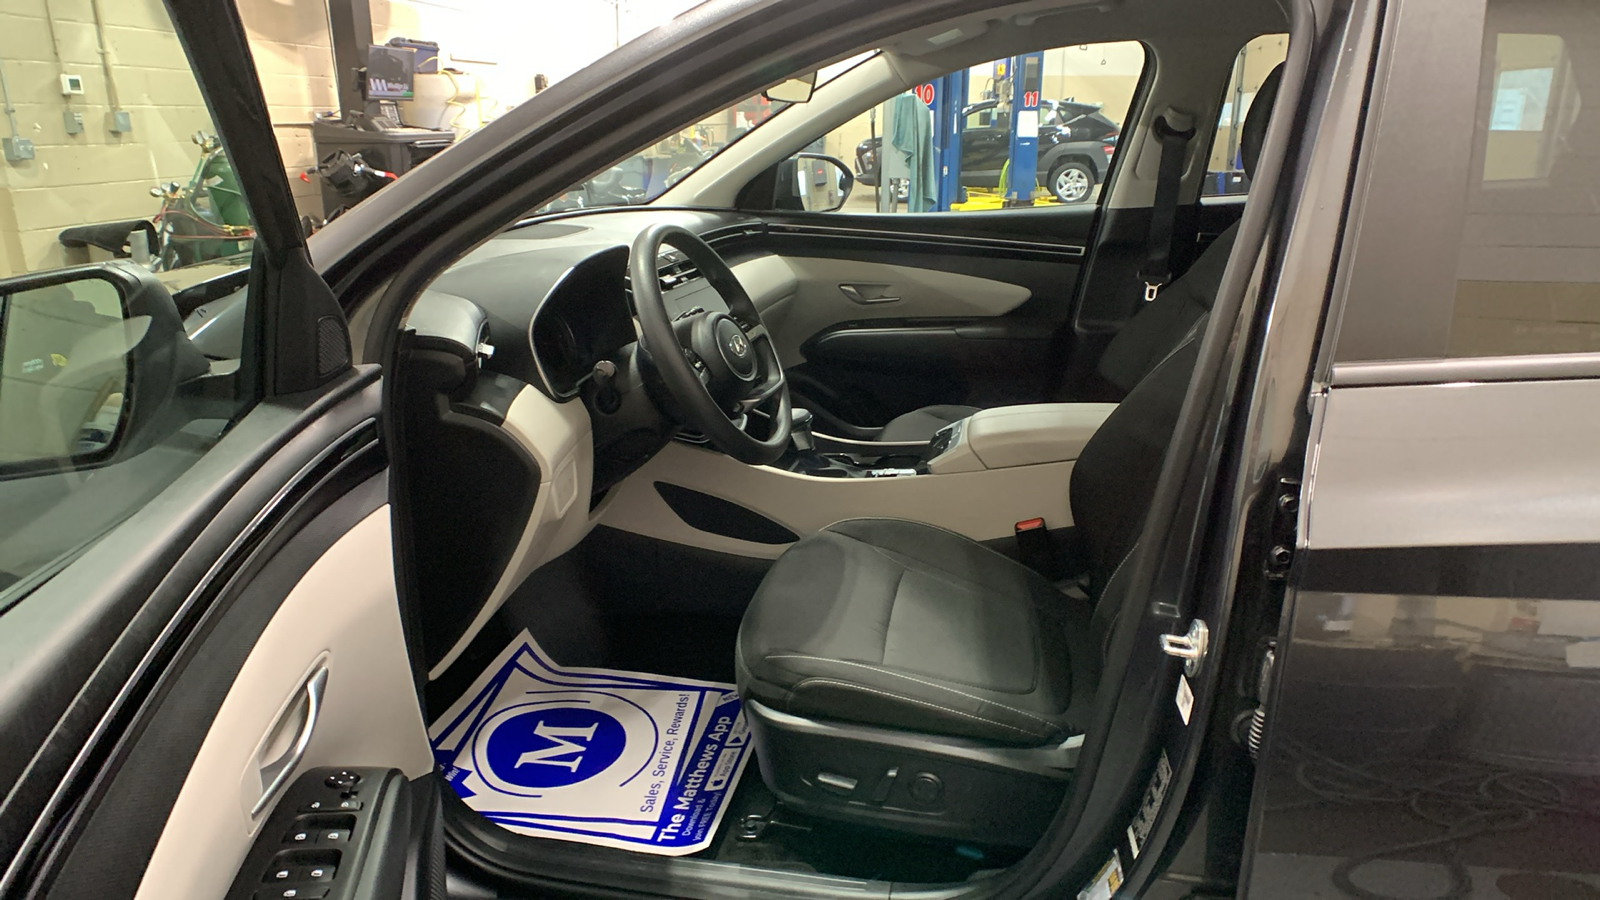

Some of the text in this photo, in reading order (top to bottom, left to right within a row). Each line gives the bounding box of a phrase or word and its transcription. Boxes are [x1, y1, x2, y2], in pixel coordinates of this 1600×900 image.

[914, 83, 935, 106] 10
[1023, 90, 1039, 108] 11
[514, 720, 600, 774] M
[640, 694, 690, 813] Sales, Service, Rewards!
[657, 813, 686, 842] The
[673, 743, 718, 810] Matthews
[708, 716, 732, 742] App
[682, 804, 703, 836] Download
[698, 813, 711, 829] FREE
[705, 791, 722, 812] Today!
